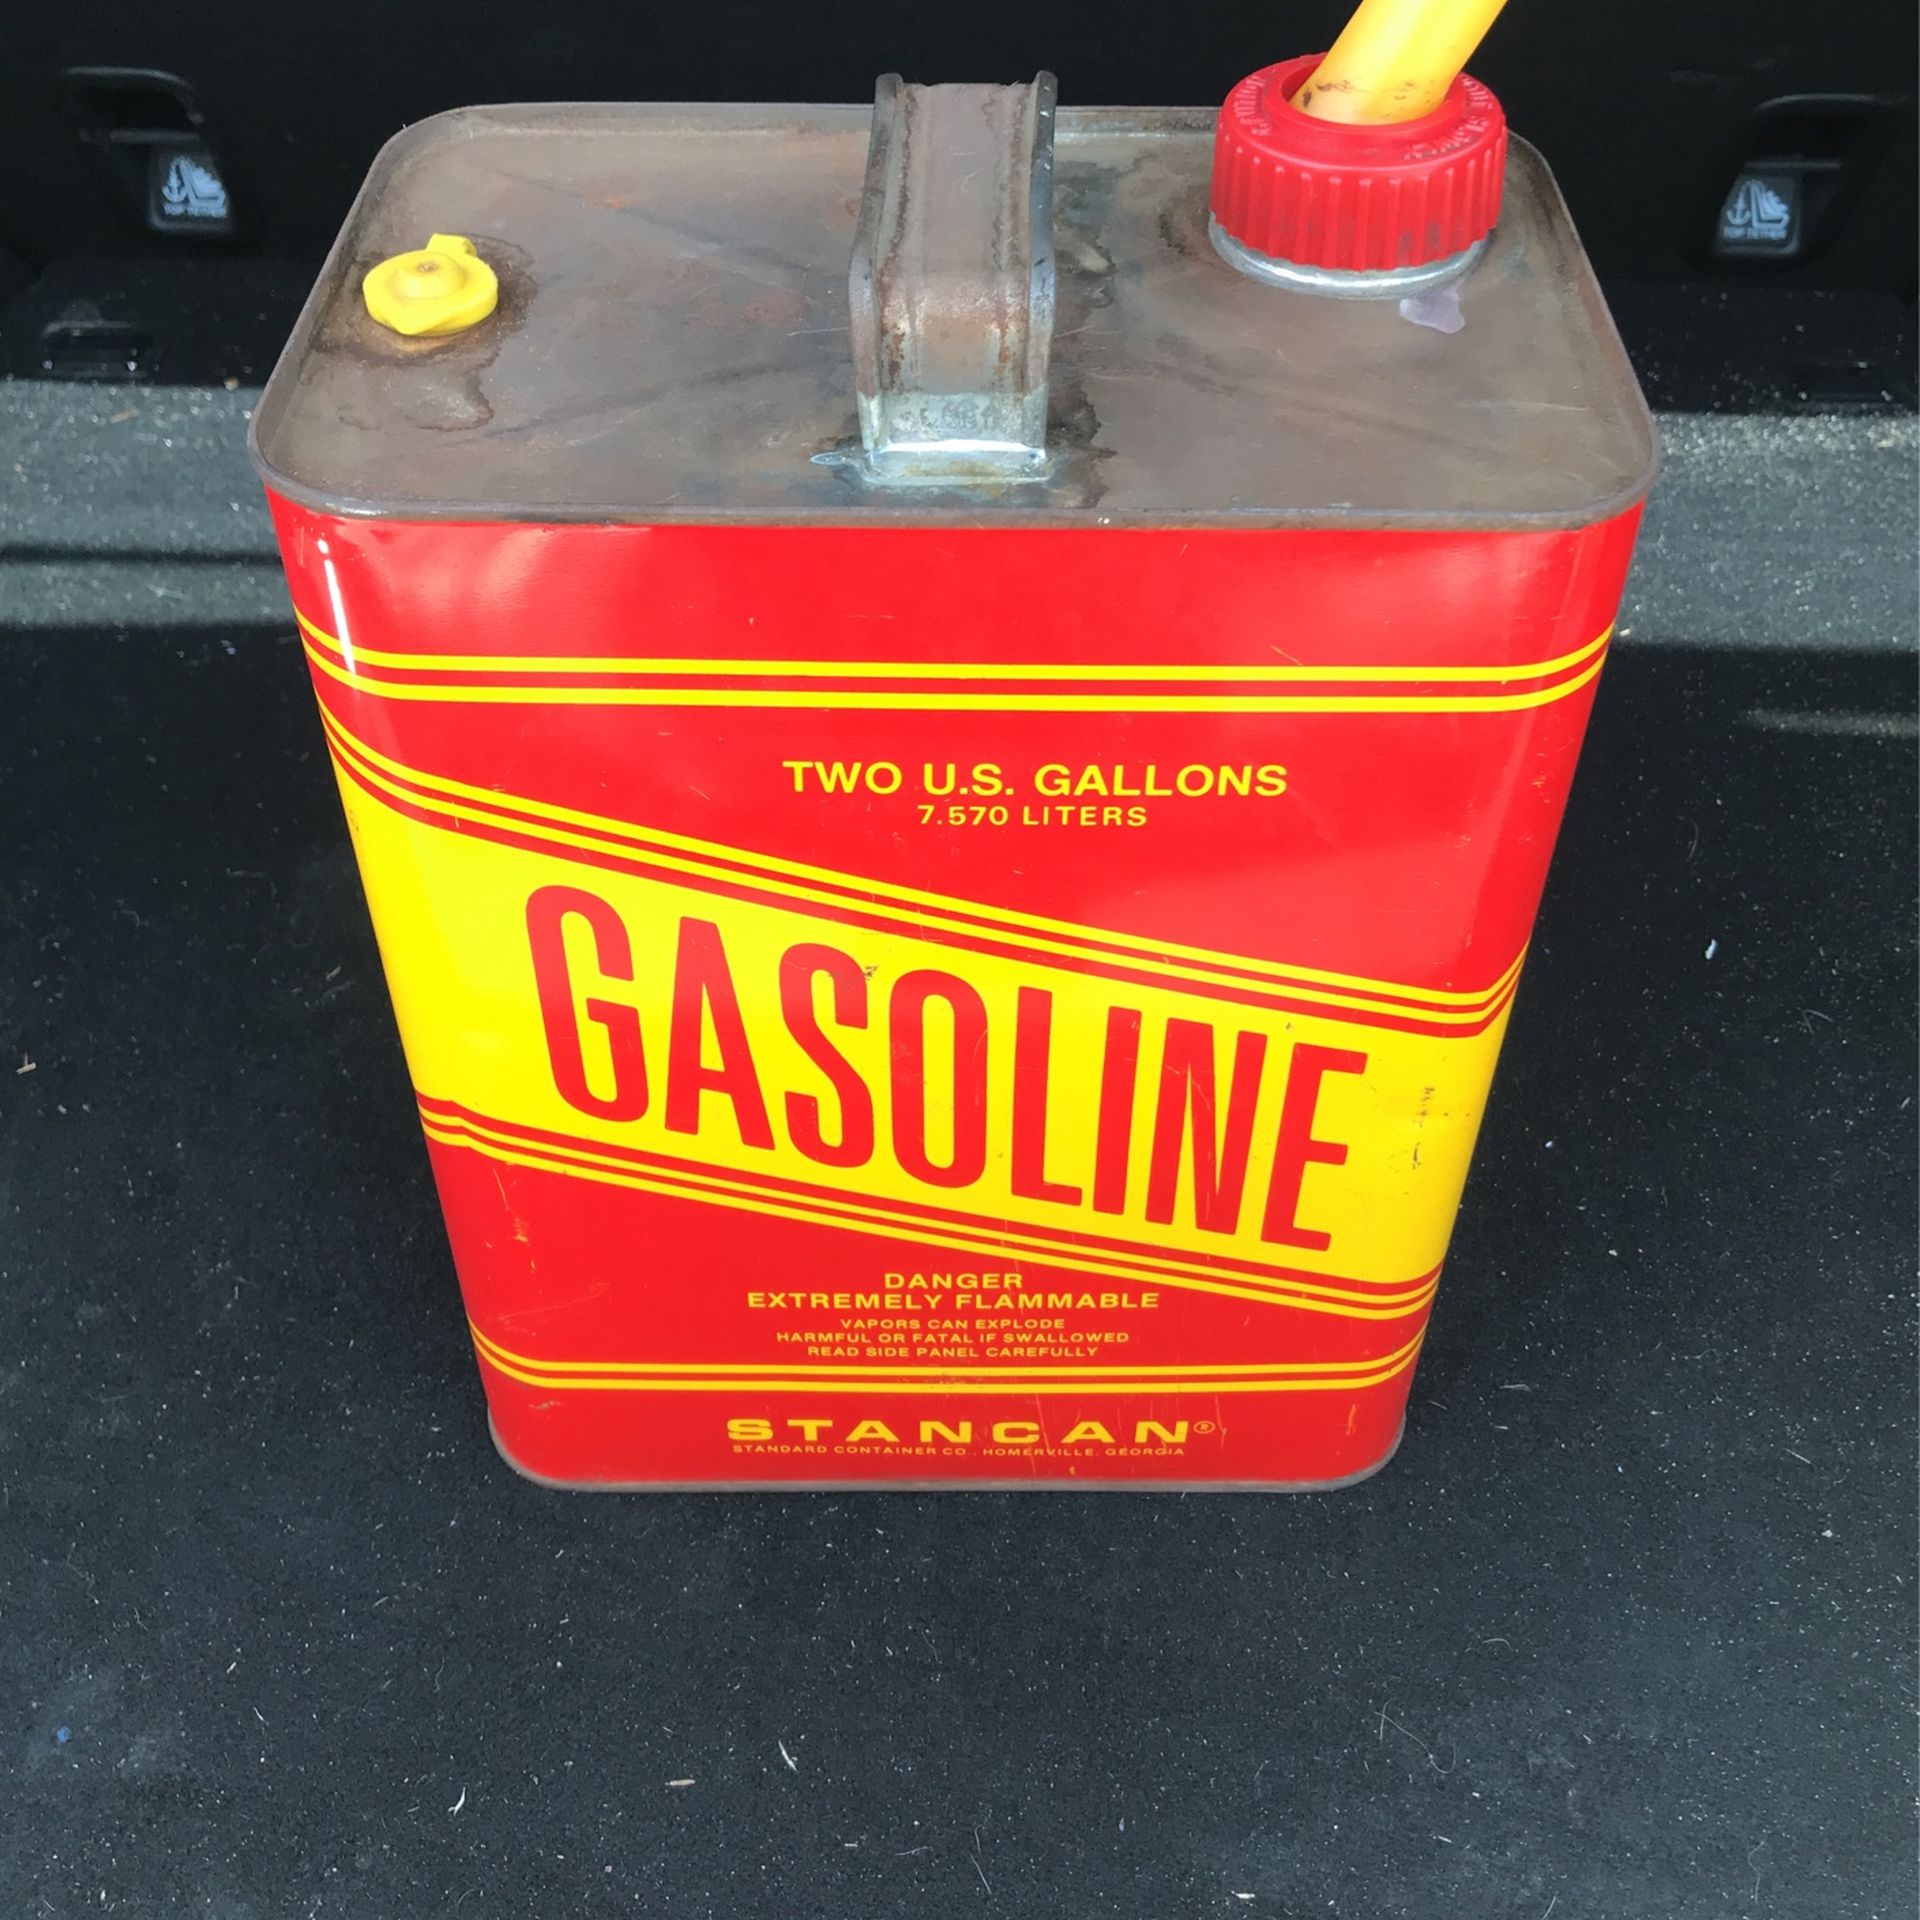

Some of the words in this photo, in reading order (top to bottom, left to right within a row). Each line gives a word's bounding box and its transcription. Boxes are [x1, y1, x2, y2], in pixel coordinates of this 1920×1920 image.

[782, 760, 904, 796] TWO
[922, 762, 1015, 797] U.S.
[1034, 763, 1289, 799] GALLONS
[917, 804, 1009, 827] 7.570
[1022, 805, 1149, 828] LITERS
[526, 885, 1368, 1251] GASOLINE
[884, 1272, 1024, 1290] DANGER
[747, 1291, 944, 1310] EXTREMELY
[955, 1292, 1160, 1310] FLAMMABLE
[840, 1318, 922, 1330] VAPORS
[927, 1318, 968, 1330] CAN
[974, 1318, 1066, 1330] EXPLODE
[776, 1332, 872, 1344] HARMFUL
[877, 1332, 905, 1344] OR
[912, 1332, 974, 1344] FATAL
[979, 1332, 997, 1344] IF
[1002, 1332, 1130, 1344] SWALLOWED
[807, 1346, 860, 1357] READ
[865, 1346, 910, 1358] SIDE
[916, 1346, 980, 1358] PANEL
[984, 1346, 1099, 1358] CAREFULLY
[732, 1444, 828, 1454] STANDARD
[833, 1445, 937, 1456] CONTAINER
[1104, 1448, 1185, 1456] GEORGIA
